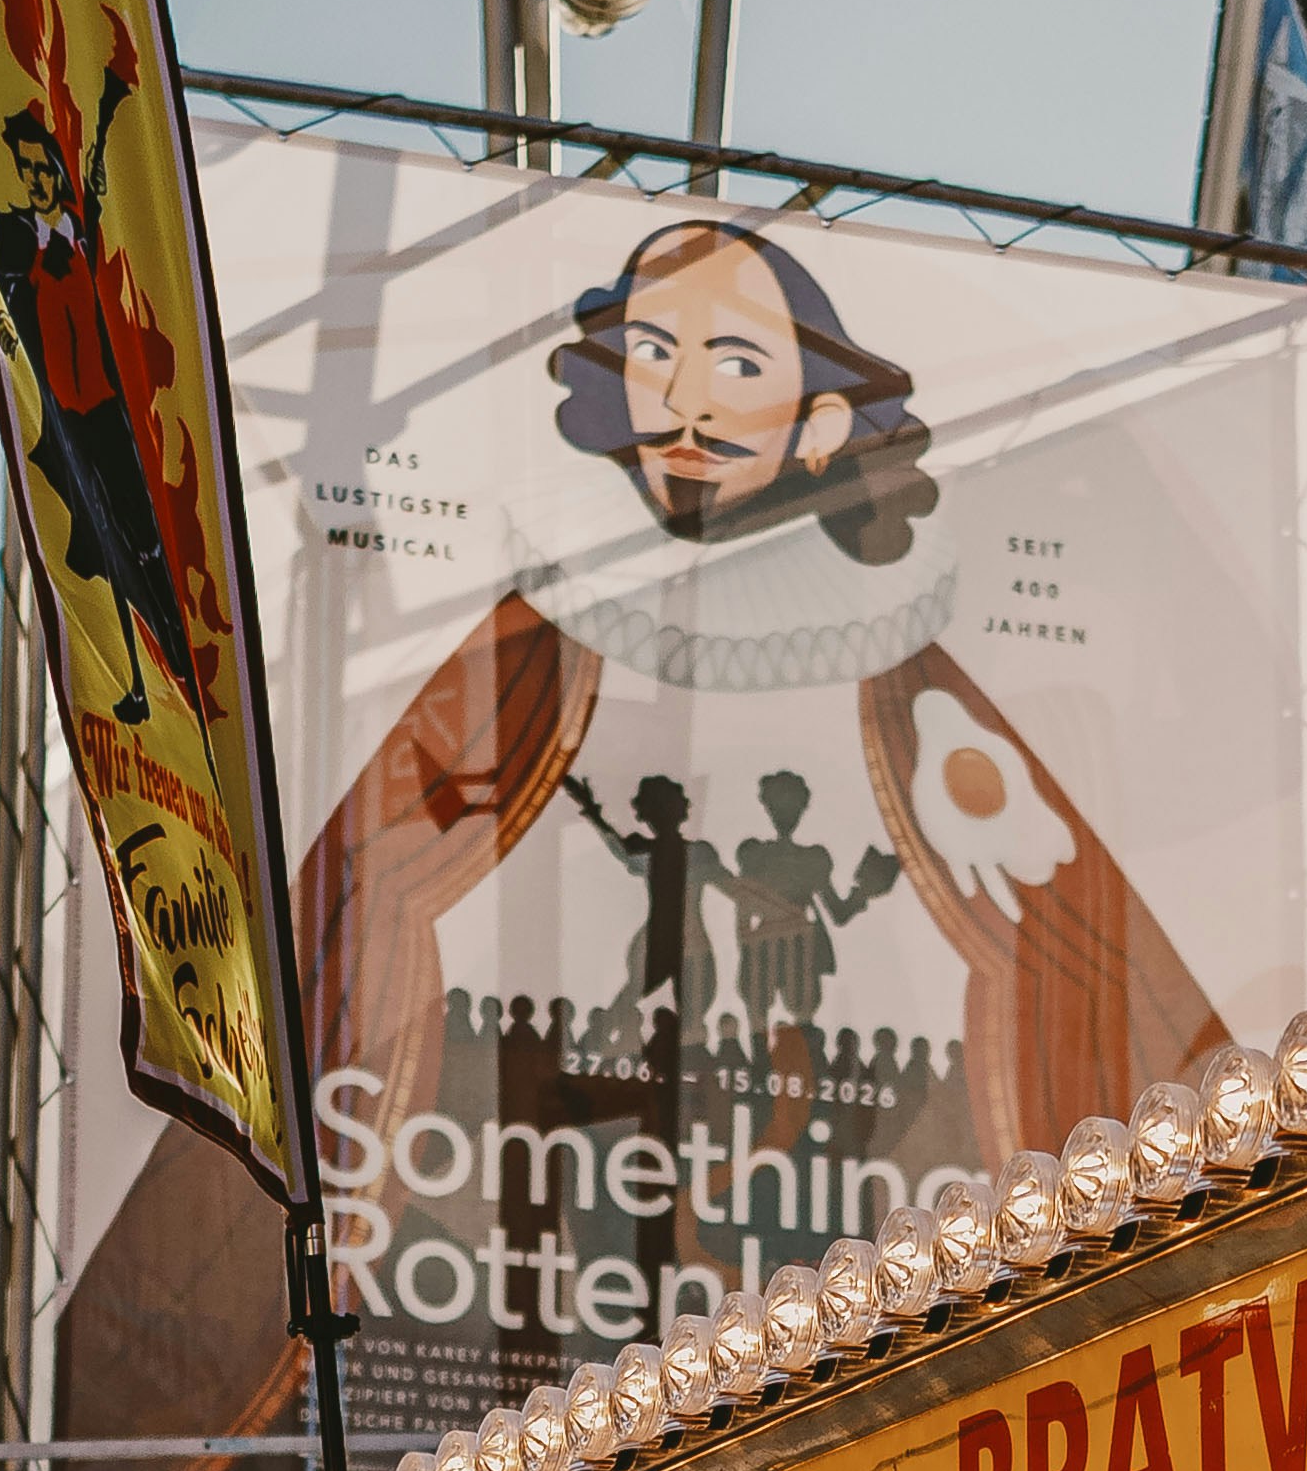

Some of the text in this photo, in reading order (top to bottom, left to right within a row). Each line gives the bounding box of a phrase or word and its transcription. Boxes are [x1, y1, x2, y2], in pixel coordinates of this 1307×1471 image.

[365, 446, 420, 470] DAS
[315, 482, 468, 520] LUSTIGSTE
[326, 527, 457, 562] MUSICAL
[1007, 536, 1064, 559] SEIT
[1011, 579, 1060, 600] 400
[983, 616, 1087, 645] JAHREN
[82, 711, 131, 800] Wir
[133, 731, 189, 825] freuen
[116, 822, 235, 956] Familie
[563, 1052, 665, 1084] 27.06.
[716, 1067, 897, 1110] 15.08.2026
[363, 1339, 407, 1357] VON
[415, 1341, 483, 1364] KAREY
[371, 1363, 416, 1382] UND
[426, 1393, 471, 1412] VON
